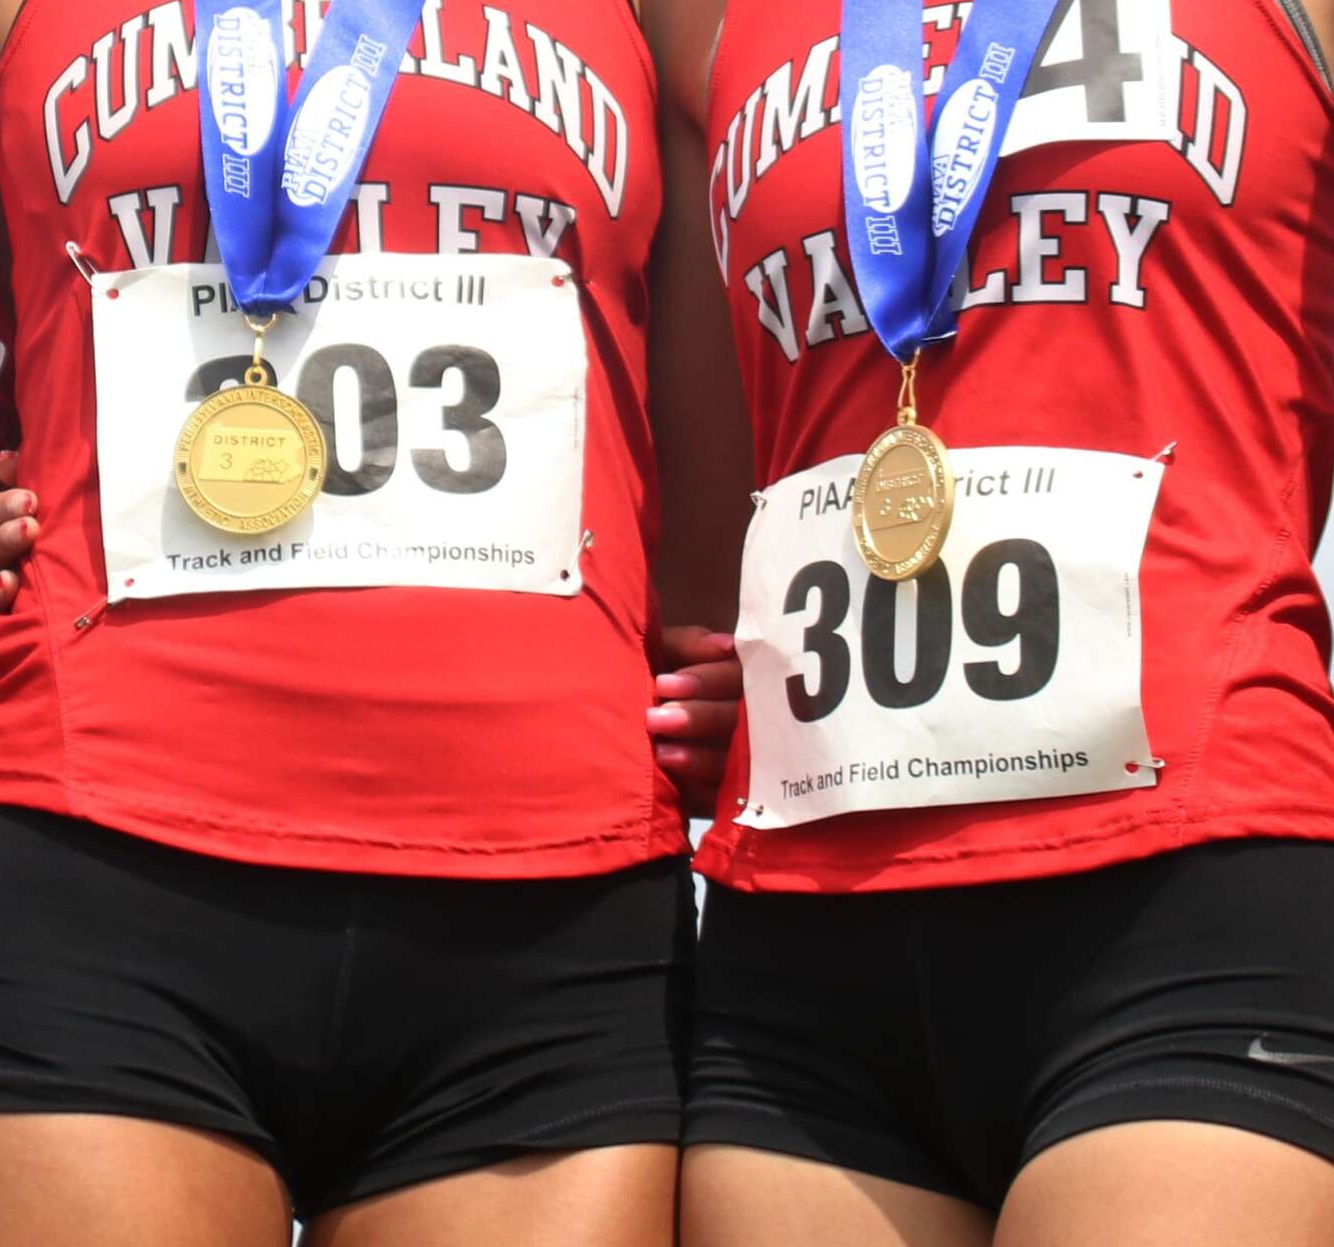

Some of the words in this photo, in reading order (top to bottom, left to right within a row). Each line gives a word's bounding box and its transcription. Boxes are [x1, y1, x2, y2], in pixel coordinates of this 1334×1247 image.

[214, 14, 248, 150] DISTRICT
[304, 71, 370, 202] DISTRICT
[859, 78, 891, 207] DISTRICT
[938, 85, 999, 231] DISTRICT
[304, 274, 443, 303] District
[456, 275, 486, 305] III
[213, 434, 287, 448] DISTRICT
[219, 452, 234, 471] 3
[1023, 467, 1055, 494] III
[167, 549, 233, 572] Track
[240, 543, 283, 565] and
[290, 541, 349, 562] Field
[783, 538, 1060, 723] 309
[781, 774, 814, 801] Track
[817, 765, 844, 789] and
[849, 759, 900, 784] Field
[908, 749, 1089, 780] Championships
